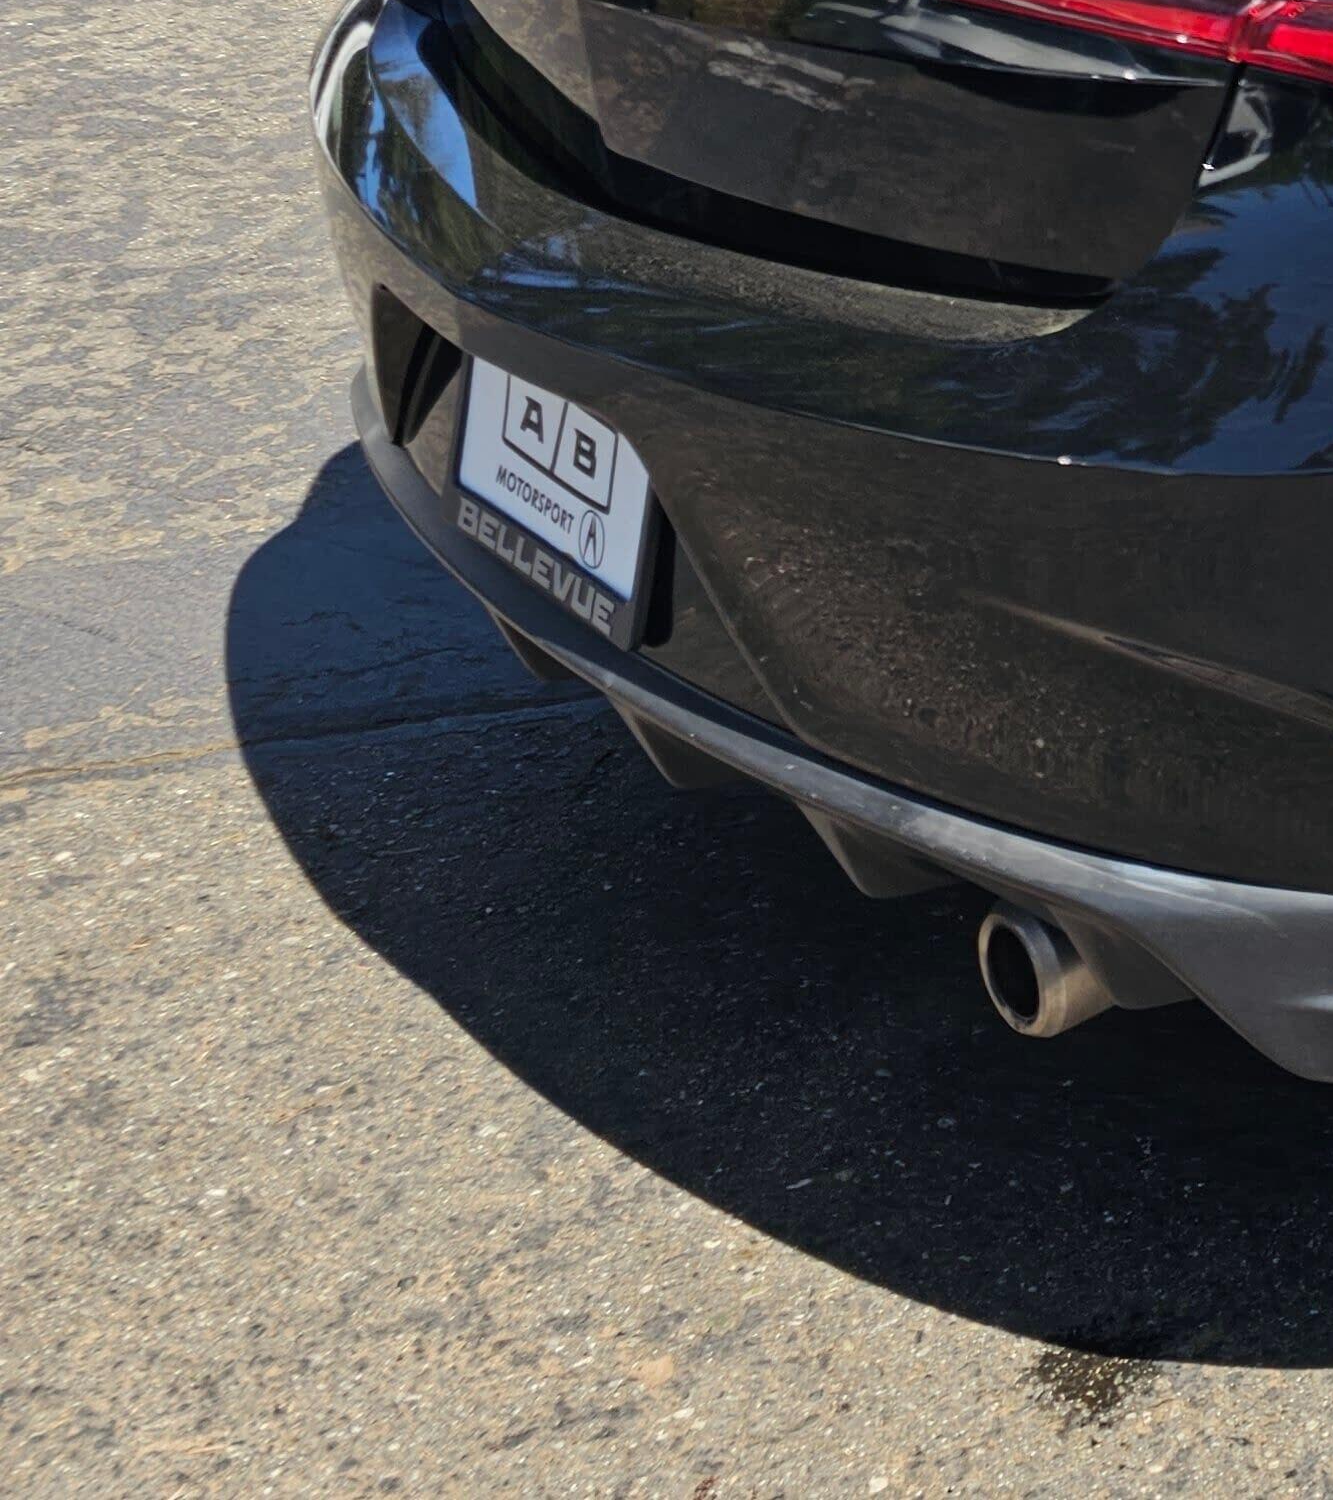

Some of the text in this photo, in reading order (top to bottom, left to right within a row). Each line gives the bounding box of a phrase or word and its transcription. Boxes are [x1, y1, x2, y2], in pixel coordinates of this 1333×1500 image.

[519, 395, 597, 480] A B
[495, 464, 575, 535] MOTORSPORT
[456, 496, 616, 637] BELLEVUE
